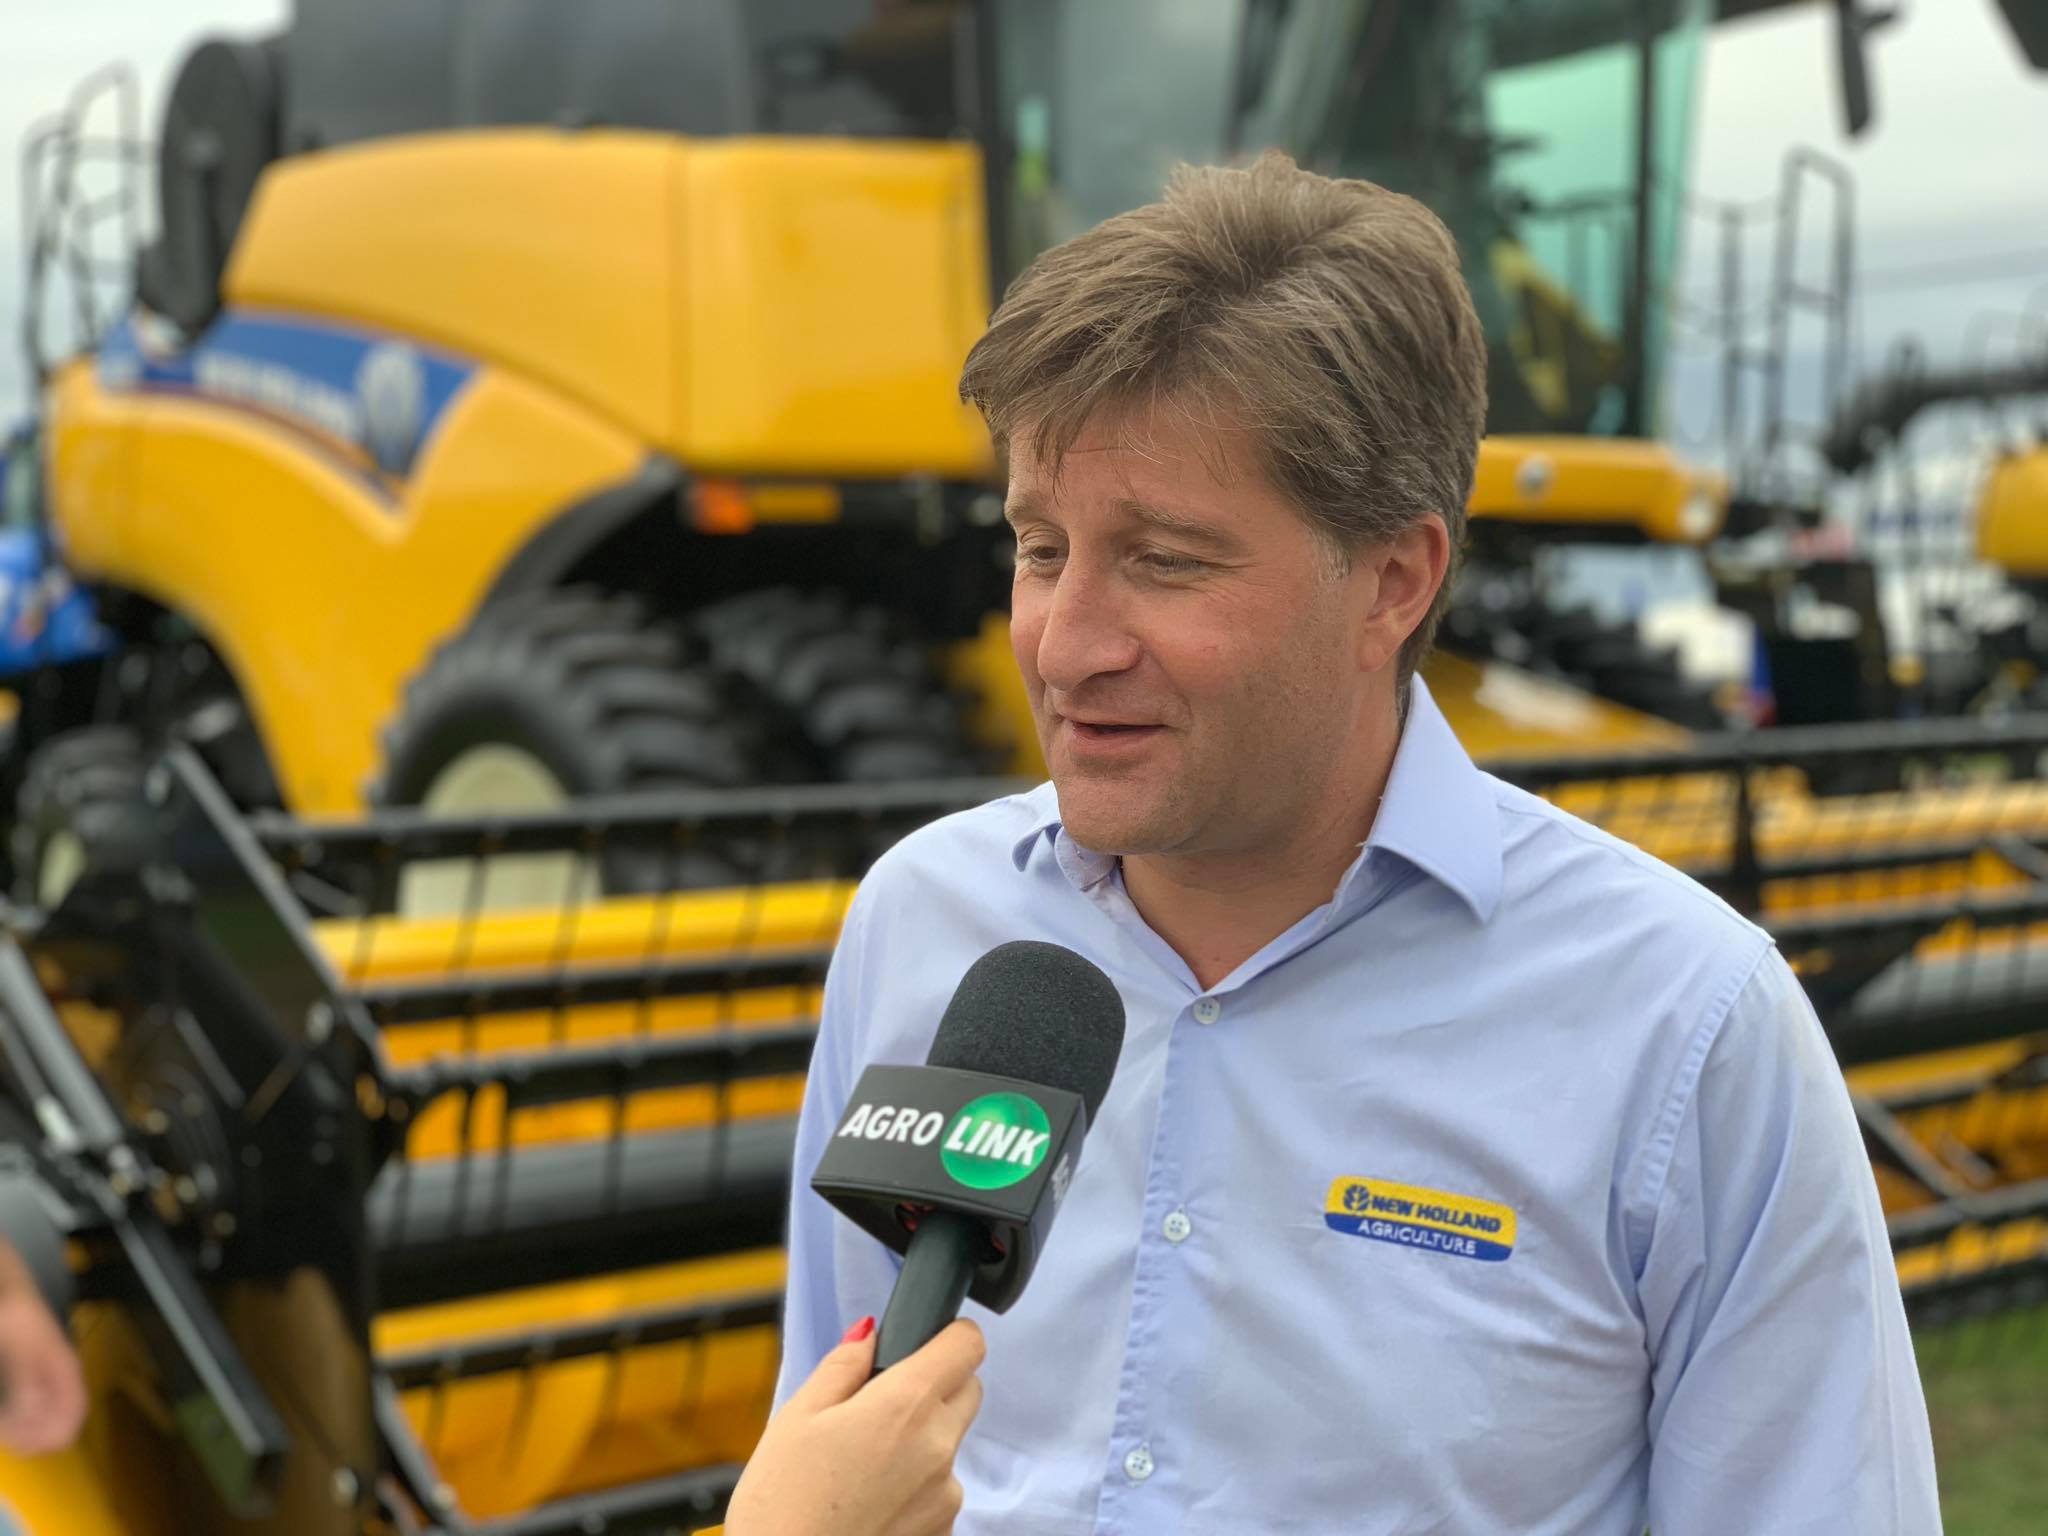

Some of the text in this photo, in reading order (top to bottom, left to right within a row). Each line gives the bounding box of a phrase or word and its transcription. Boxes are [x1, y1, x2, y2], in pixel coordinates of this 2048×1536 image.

[839, 1104, 1049, 1166] AGRO LINK
[1372, 1195, 1501, 1232] NEW HOLLAND
[1357, 1219, 1477, 1255] AGRICULTURE
